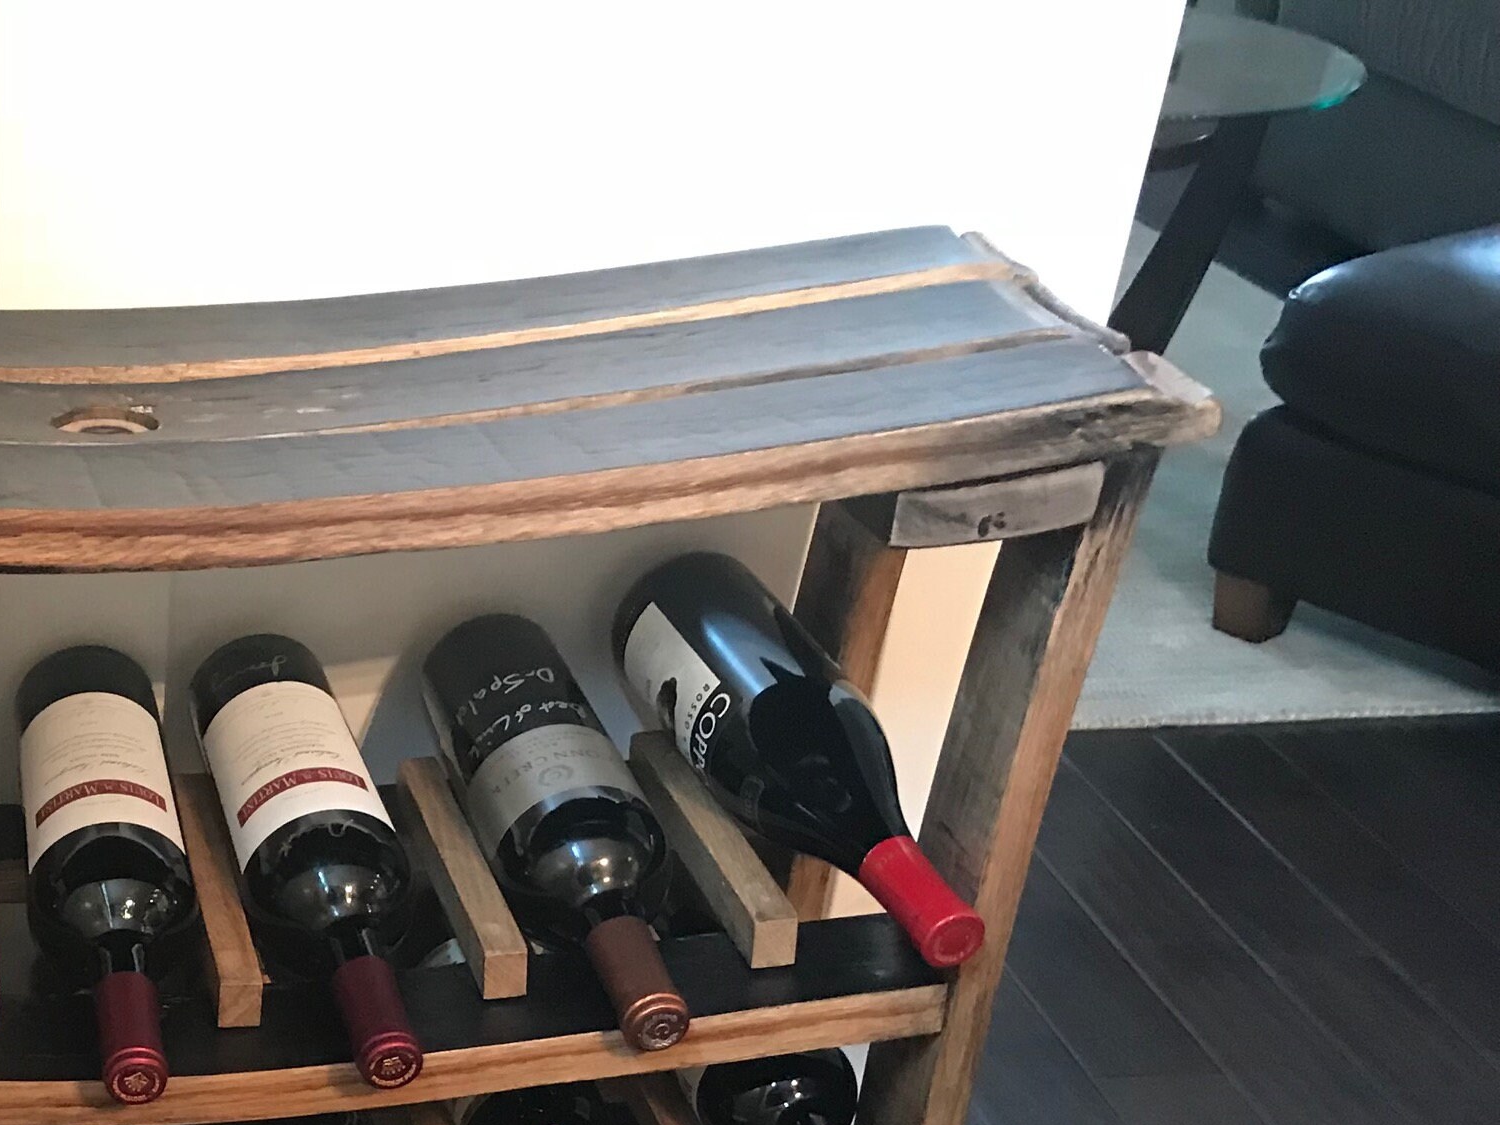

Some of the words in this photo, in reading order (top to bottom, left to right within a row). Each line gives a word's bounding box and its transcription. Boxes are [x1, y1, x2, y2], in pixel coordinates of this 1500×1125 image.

[684, 683, 711, 731] ROSSO
[118, 782, 161, 807] LOUIS
[239, 773, 298, 818] MARTINI
[317, 769, 363, 787] LOUIS
[39, 783, 99, 818] MARTINI
